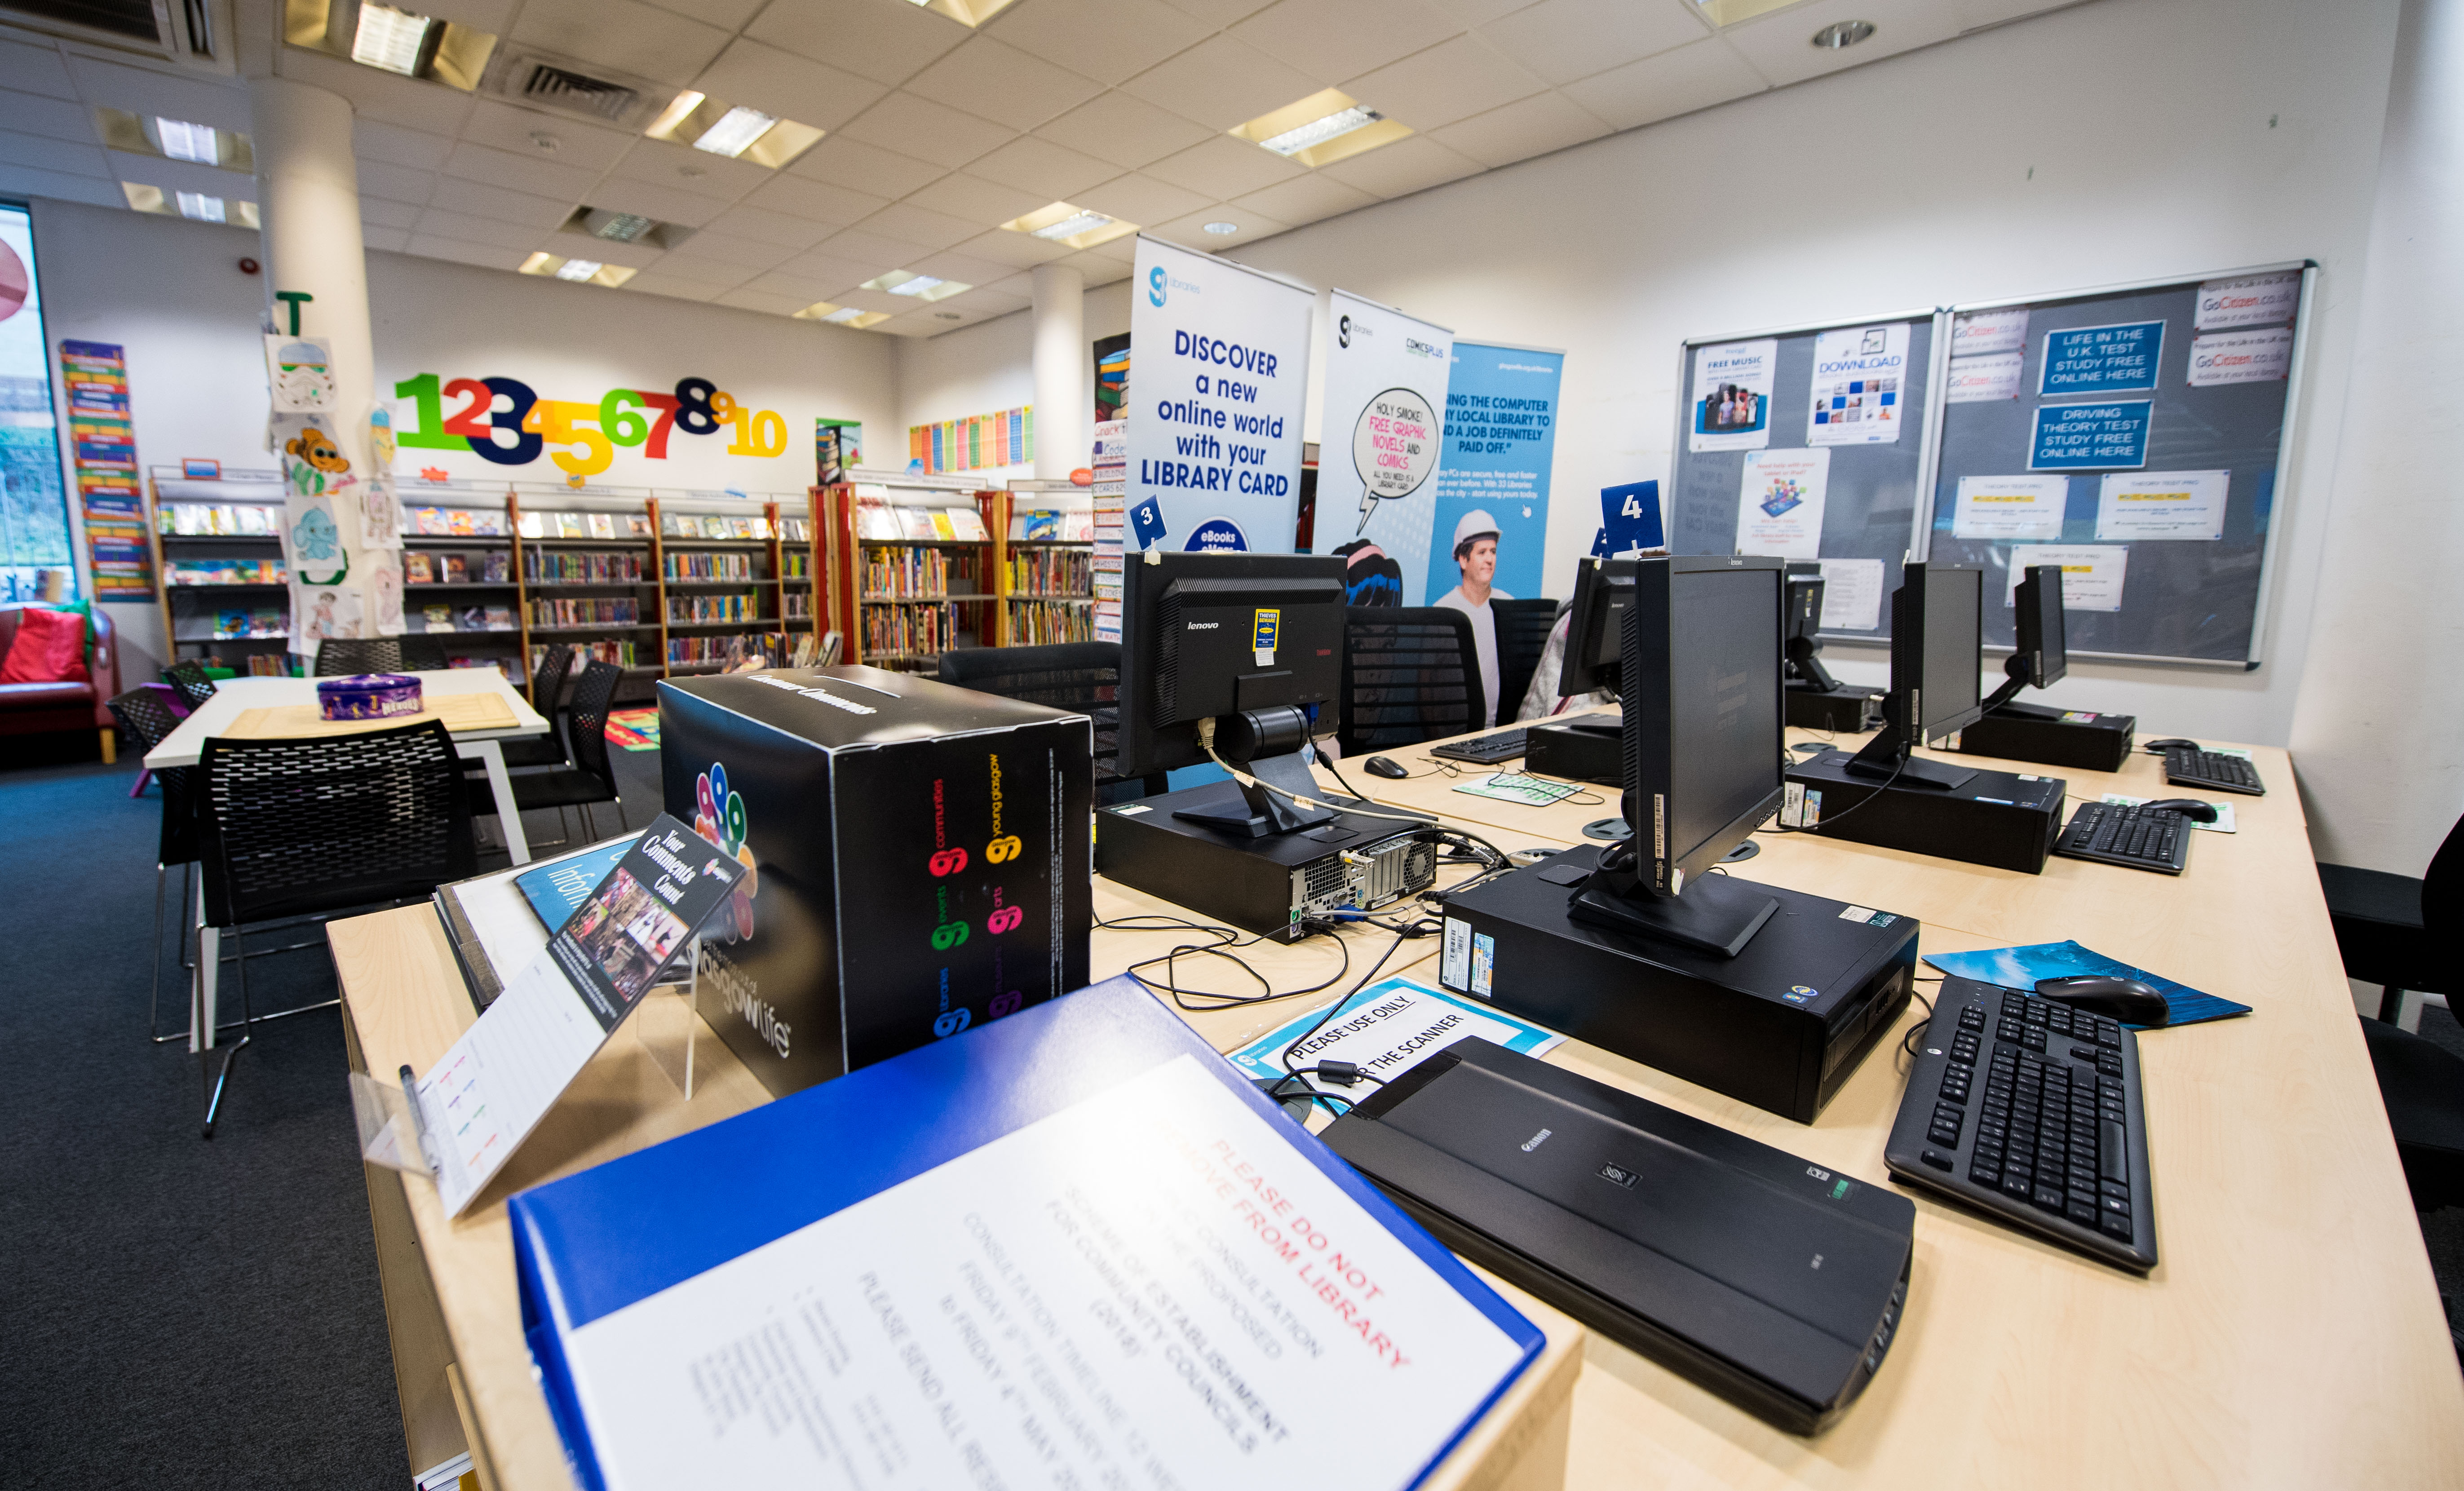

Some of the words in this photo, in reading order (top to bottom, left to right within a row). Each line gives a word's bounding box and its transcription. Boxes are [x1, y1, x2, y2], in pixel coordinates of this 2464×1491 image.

[1175, 329, 1277, 378] DISCOVER
[2063, 333, 2093, 346] LIFE
[2096, 332, 2112, 342] IN
[2115, 329, 2144, 341] THE
[2099, 342, 2137, 355] TEST
[1708, 360, 1729, 368] FREE
[1732, 356, 1763, 366] MUSIC
[1819, 355, 1902, 373] DOWNLOAD
[2050, 371, 2102, 384] ONLINE
[2106, 368, 2147, 380] HERE
[2055, 358, 2103, 372] STUDY
[2106, 355, 2146, 368] FREE
[1195, 374, 1209, 395] a
[1217, 378, 1258, 403] new
[1447, 394, 1467, 407] ING
[1471, 395, 1490, 408] THE
[1492, 397, 1548, 412] COMPUTER
[395, 372, 475, 452] 1
[441, 378, 493, 438] 2
[466, 377, 543, 465] 3
[522, 399, 563, 443] 4
[600, 388, 648, 447] 6
[675, 377, 720, 435] 8
[710, 391, 737, 425] 9
[1158, 399, 1226, 429] online
[1234, 412, 1283, 438] world
[1377, 402, 1394, 416] HOLY
[1397, 407, 1423, 423] SMOKE!
[1457, 410, 1491, 423] LOCAL
[1493, 412, 1535, 426] LIBRARY
[1537, 415, 1550, 427] TO
[2062, 408, 2122, 420] DRIVING
[551, 400, 614, 476] 5
[631, 390, 683, 460] 7
[727, 407, 787, 458] 10
[1369, 416, 1390, 433] FREE
[1393, 421, 1426, 440] GRAPHIC
[1456, 425, 1463, 437] A
[1465, 426, 1487, 438] JOB
[1490, 427, 1543, 441] DEFINITELY
[2043, 422, 2101, 433] THEORY
[2104, 420, 2141, 431] TEST
[2045, 434, 2092, 446] STUDY
[2094, 433, 2133, 444] FREE
[1104, 443, 1124, 455] Code
[1176, 435, 1221, 460] with
[1228, 443, 1266, 466] your
[1373, 434, 1405, 452] NOVELS
[1407, 442, 1420, 454] AND
[1459, 441, 1483, 453] PAID
[2039, 447, 2091, 458] ONLINE
[2094, 446, 2135, 457] HERE
[1377, 453, 1408, 469] COMICS
[1393, 473, 1404, 481] NEED
[1141, 459, 1232, 491] LIBRARY
[1238, 473, 1288, 496] CARD
[1378, 480, 1395, 489] LIBRARY
[1140, 507, 1154, 525] 3
[1621, 494, 1642, 519] 4
[1201, 530, 1235, 543] eBooks
[1187, 620, 1219, 630] lenovo
[747, 675, 808, 690] Customer
[989, 753, 1003, 801] glasgow
[933, 779, 945, 849] communities
[992, 801, 1004, 838] young
[661, 829, 686, 853] Your
[641, 835, 696, 885] Comments
[654, 874, 686, 905] Count
[937, 885, 947, 924] events
[993, 886, 1003, 908] arts
[697, 937, 792, 1059] lasgowlife
[939, 966, 949, 1013] libraries
[1290, 1029, 1349, 1060] PLEASE
[1344, 1015, 1377, 1032] USE
[1371, 995, 1410, 1018] ONLY
[1368, 1051, 1405, 1069] THE
[1398, 1014, 1464, 1054] SCANNER
[1521, 1128, 1552, 1152] Canon
[1212, 1138, 1293, 1218] PLEASE
[1291, 1216, 1328, 1252] DO
[1329, 1251, 1385, 1301] NOT
[1198, 1227, 1324, 1359] CONSULTATION
[1233, 1198, 1299, 1264] FROM
[1299, 1264, 1411, 1369] LIBRARY
[962, 1212, 1060, 1340] CONSULTATION
[1057, 1337, 1130, 1426] TIMELINE
[1189, 1259, 1283, 1359] PROPOSED
[1046, 1199, 1080, 1236] FOR
[1076, 1235, 1169, 1342] COMMUNITY
[1165, 1342, 1258, 1456] COUNCILS
[858, 1271, 911, 1345] PLEASE
[900, 1341, 944, 1402] SEND
[937, 1400, 968, 1445] ALL
[959, 1260, 1011, 1323] FRIDAY
[1024, 1352, 1111, 1464] FEBRUARY
[1146, 1282, 1292, 1444] ESTABLISHMENT
[953, 1310, 1006, 1382] FRIDAY
[1022, 1413, 1062, 1464] MAY
